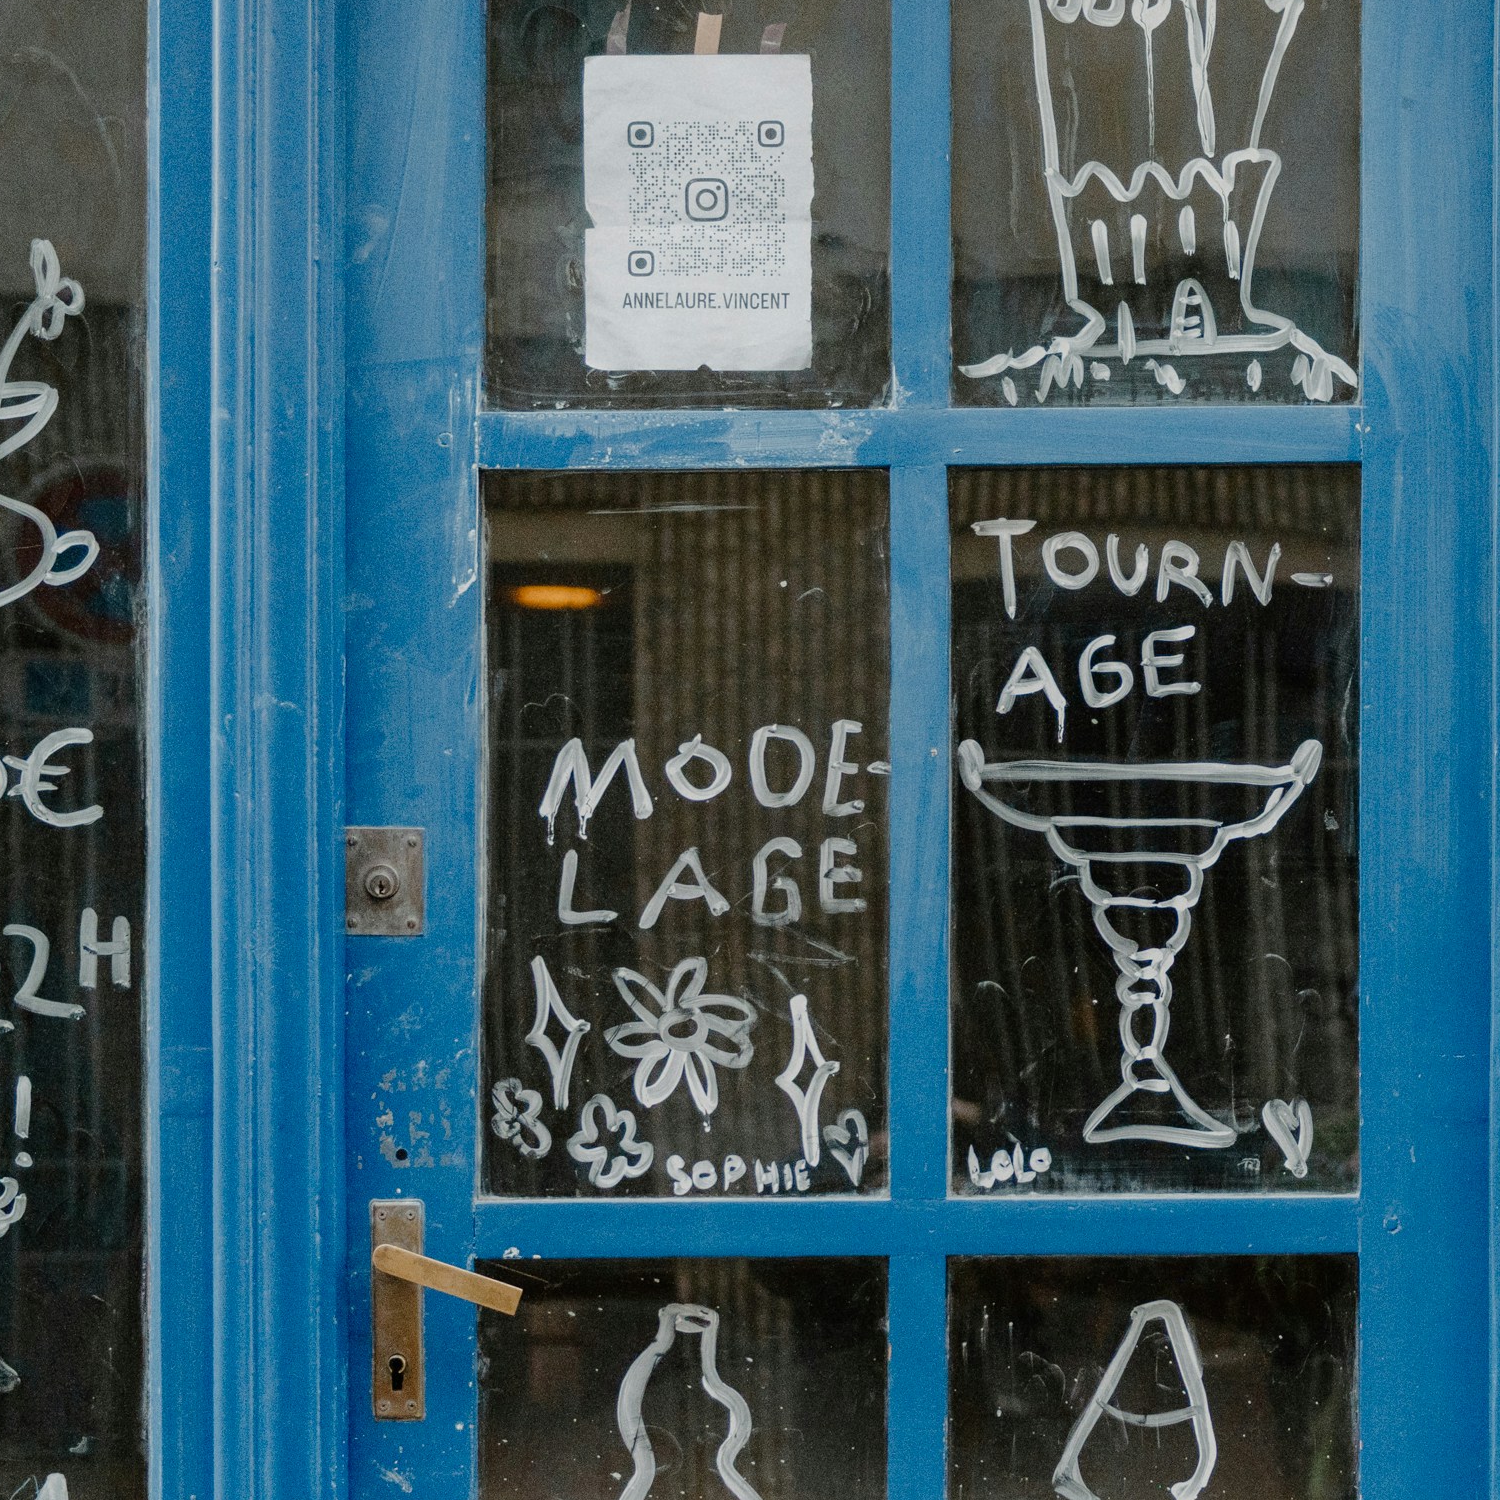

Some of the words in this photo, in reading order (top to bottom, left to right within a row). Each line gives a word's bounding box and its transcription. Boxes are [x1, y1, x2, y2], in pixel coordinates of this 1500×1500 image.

[623, 292, 790, 309] ANNELAURE.VINCENT
[996, 625, 1201, 713] AGE
[558, 837, 867, 929] LAGE
[666, 1154, 812, 1195] SOPHIE
